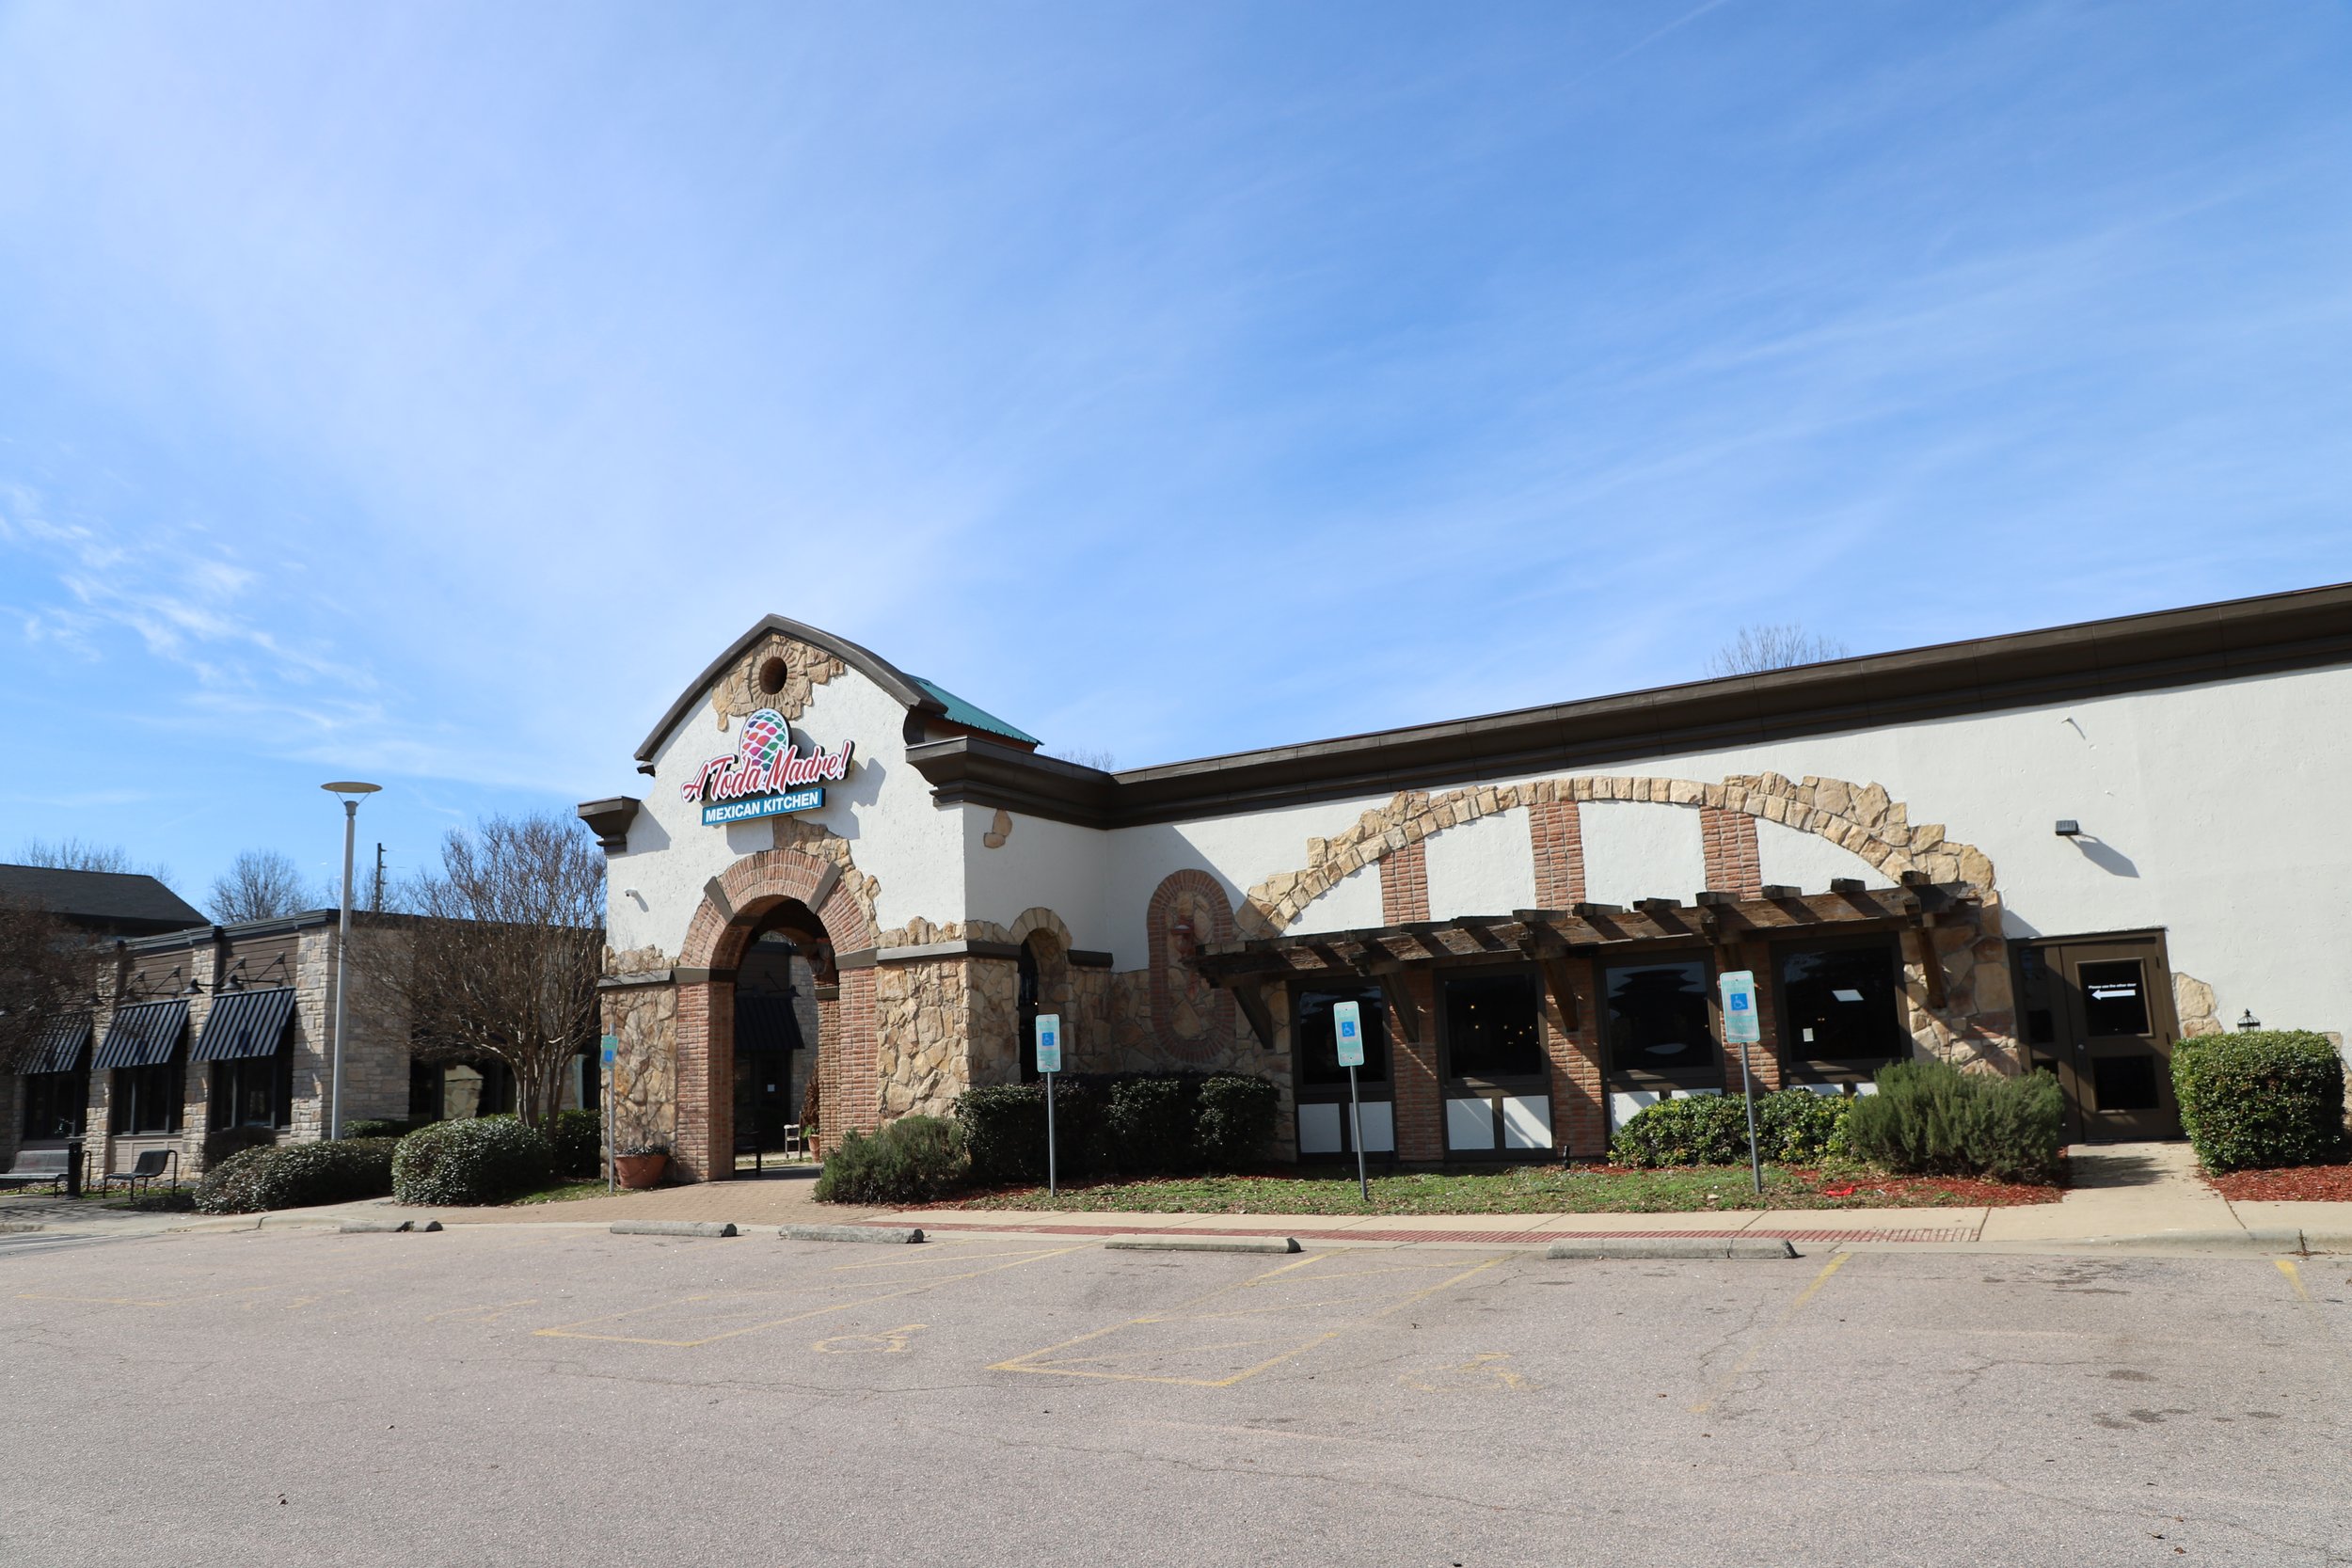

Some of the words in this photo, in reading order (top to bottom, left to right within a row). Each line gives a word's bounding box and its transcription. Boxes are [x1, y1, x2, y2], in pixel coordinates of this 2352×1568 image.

[682, 763, 709, 800] A
[709, 755, 762, 798] Toda
[765, 741, 850, 792] Madre!
[706, 805, 760, 823] MEXICAN
[763, 791, 818, 813] KITCHEN
